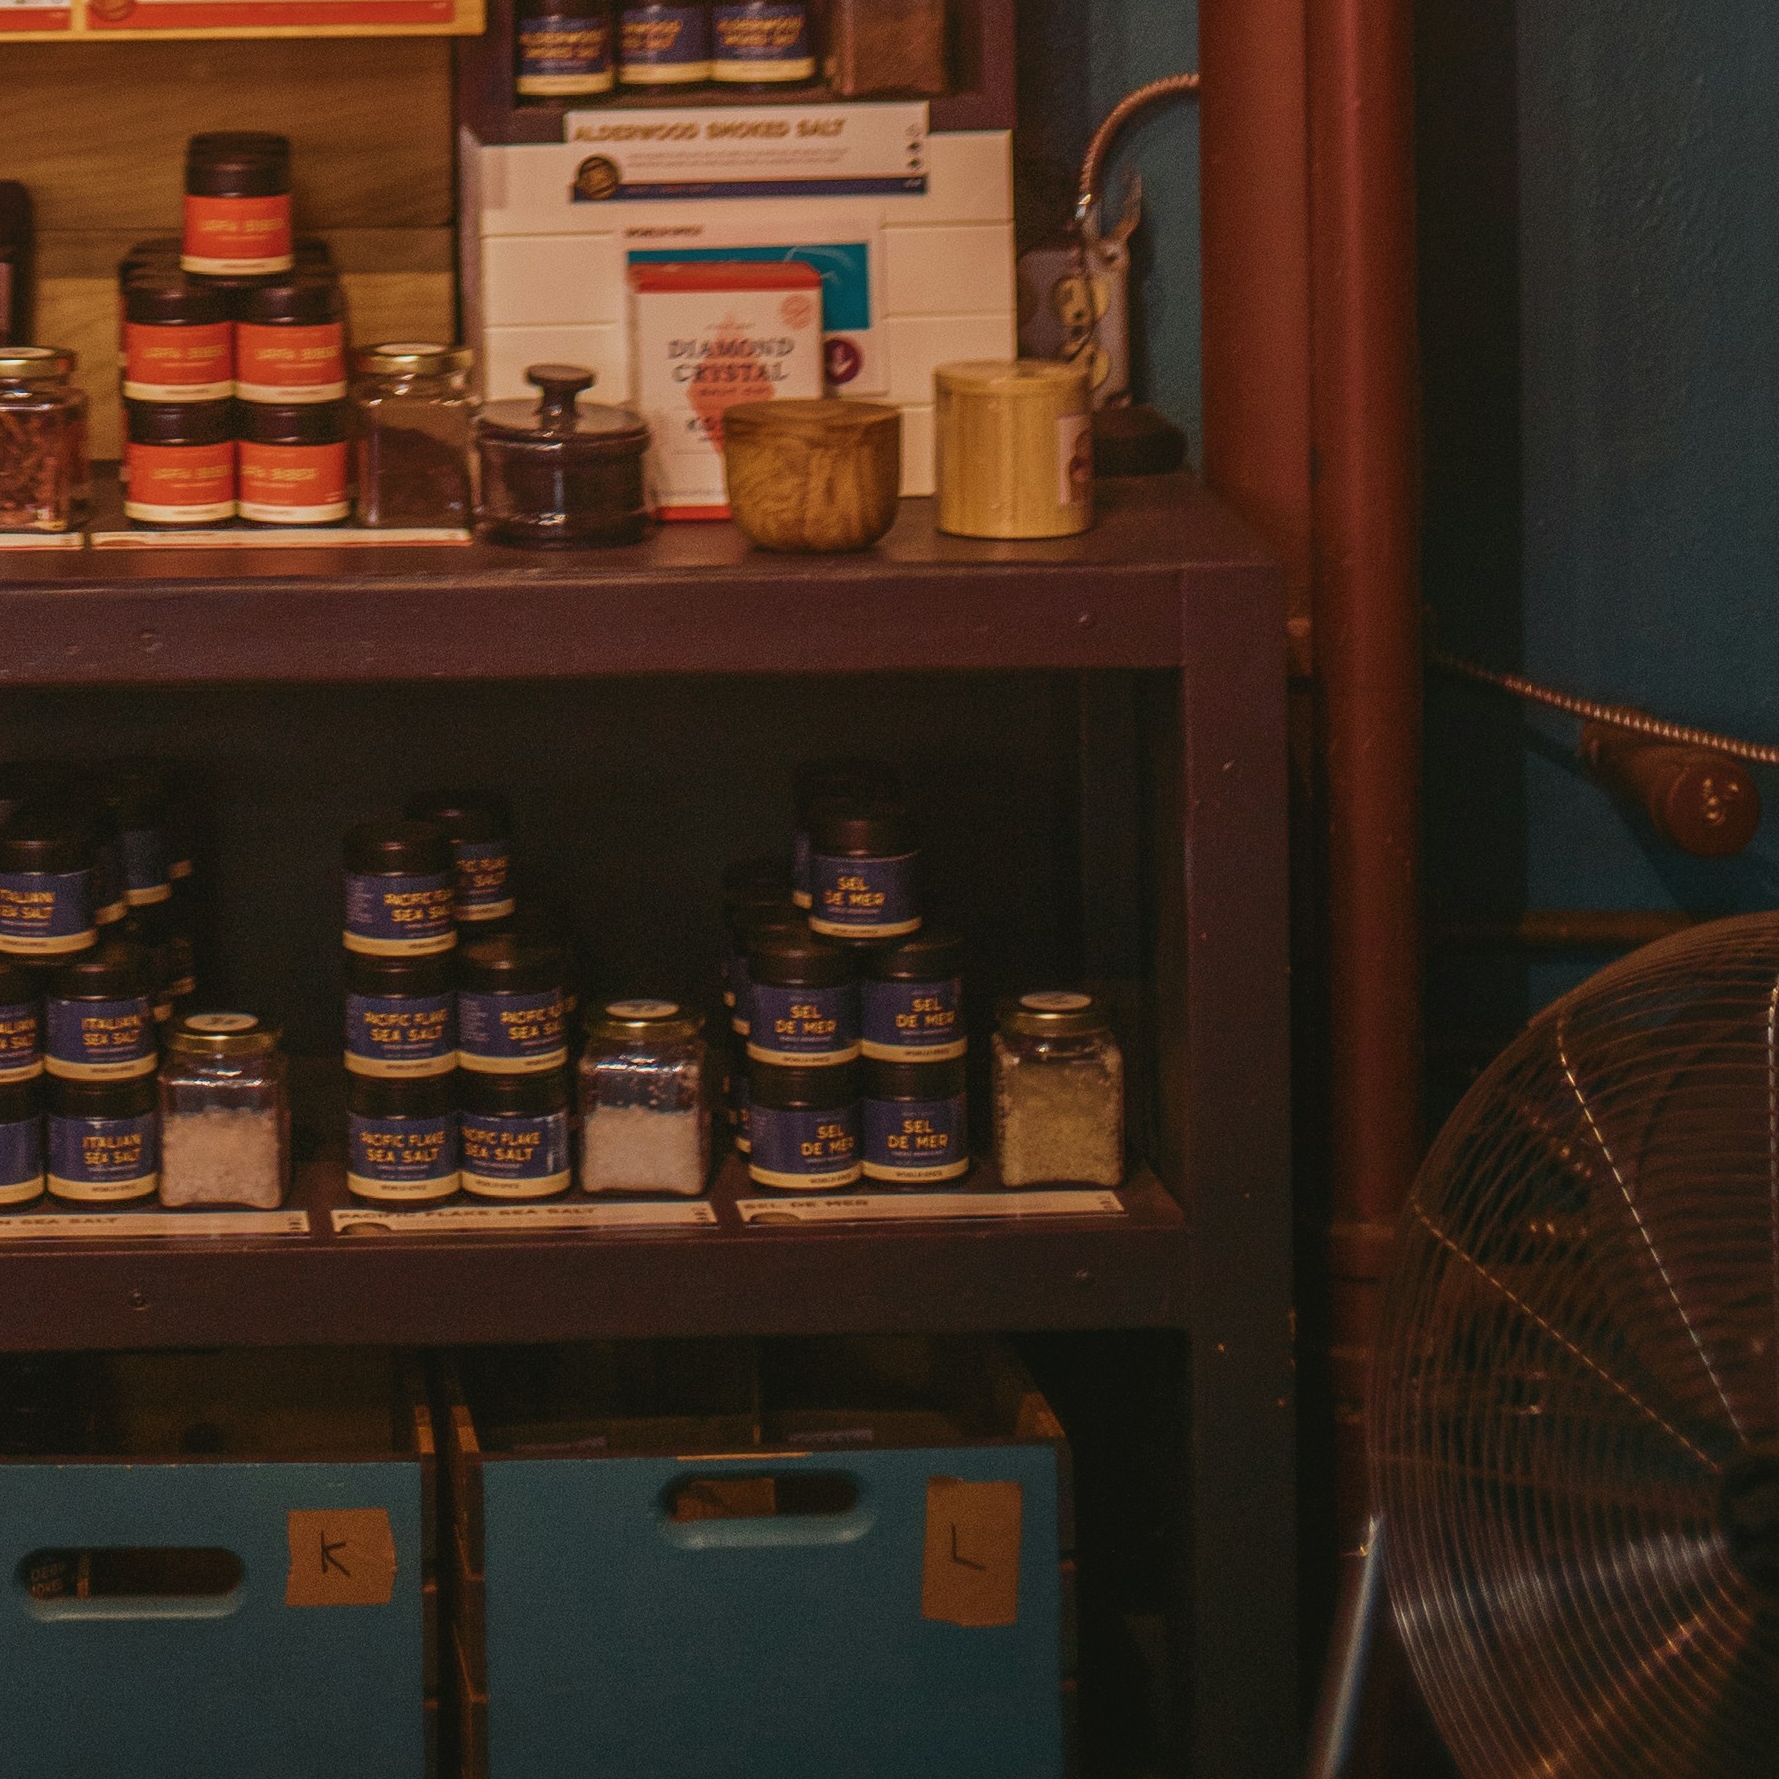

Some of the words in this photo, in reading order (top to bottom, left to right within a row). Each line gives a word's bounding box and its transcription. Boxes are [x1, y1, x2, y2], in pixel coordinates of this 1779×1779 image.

[574, 123, 700, 143] ALDERWOOD
[704, 120, 790, 140] SMOKED
[796, 118, 848, 138] SALT
[667, 337, 796, 360] DIAMOND
[836, 876, 869, 892] SEL
[823, 891, 845, 907] DE
[847, 892, 886, 907] MER
[789, 1004, 822, 1019] SEL
[911, 997, 943, 1012] SEL
[81, 1013, 141, 1031] ITALIAN
[894, 1013, 919, 1028] DE
[923, 1010, 956, 1026] MER
[369, 1027, 402, 1043] SEA
[407, 1025, 444, 1042] SALT
[507, 1025, 540, 1041] SEA
[774, 1020, 797, 1035] DE
[801, 1020, 837, 1035] MER
[81, 1032, 109, 1047] SEA
[816, 1123, 845, 1140] SEL
[902, 1119, 934, 1135] SEL
[82, 1132, 142, 1150] ITALIAN
[500, 1131, 541, 1147] FLAKE
[886, 1134, 909, 1150] DE
[914, 1133, 949, 1149] MER
[364, 1147, 397, 1163] SEA
[401, 1147, 440, 1163] SALT
[493, 1146, 534, 1162] SALT
[800, 1141, 823, 1157] DE
[83, 1150, 109, 1166] SEA
[319, 1529, 351, 1578] K
[950, 1521, 987, 1571] L
